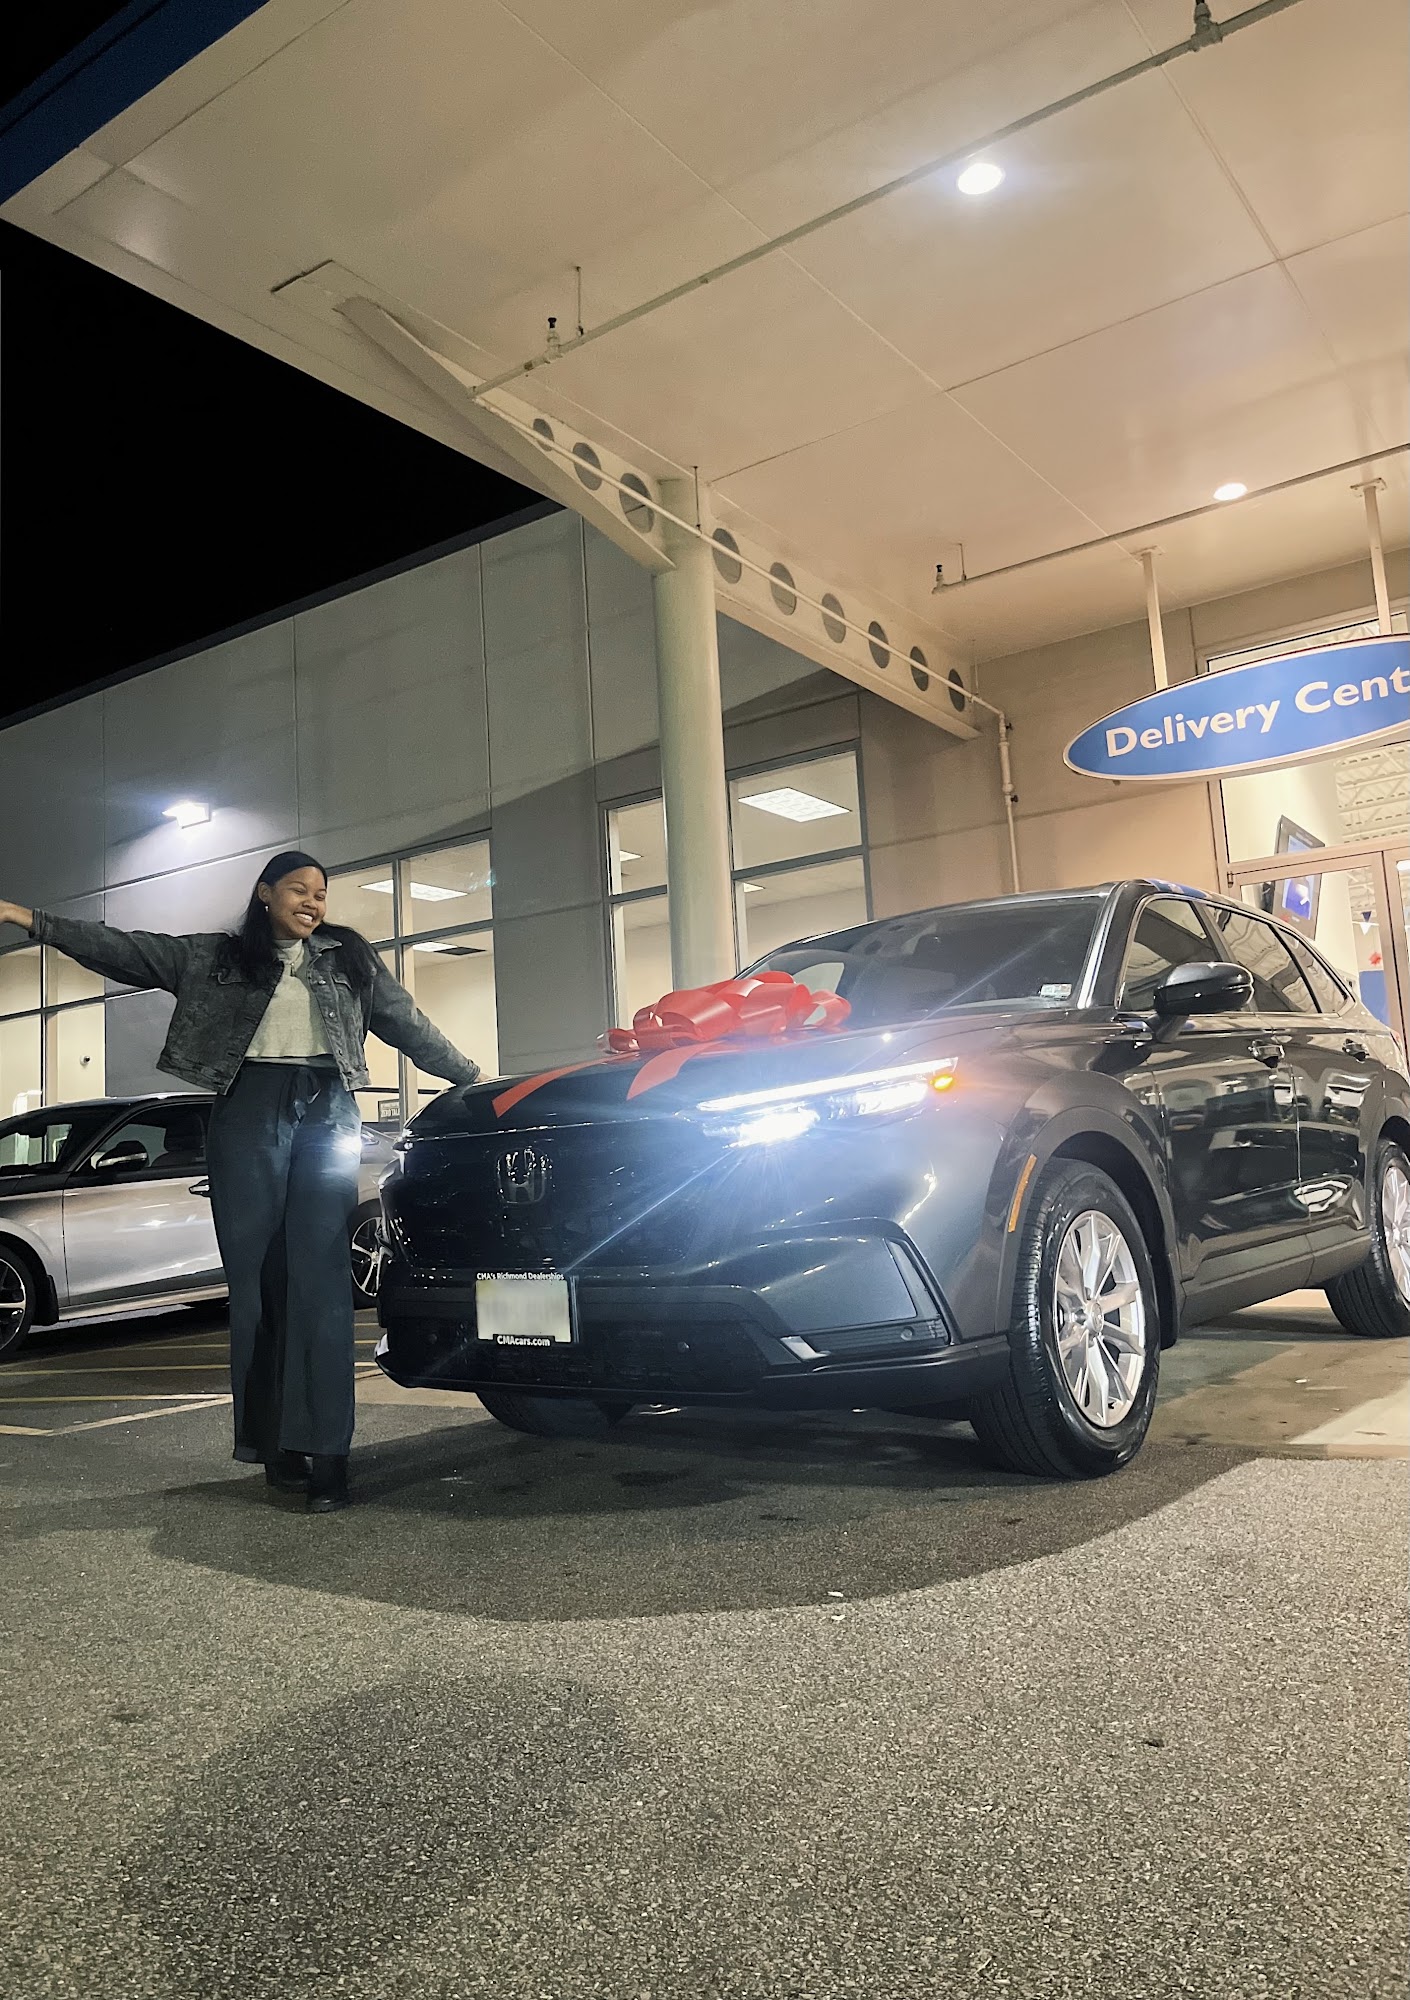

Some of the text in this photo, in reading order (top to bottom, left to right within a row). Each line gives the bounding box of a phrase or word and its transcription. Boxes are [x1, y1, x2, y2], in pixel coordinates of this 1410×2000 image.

[1105, 666, 1410, 758] Delivery Cent
[496, 1272, 527, 1280] Richmond
[528, 1272, 564, 1281] Dealerships
[496, 1335, 551, 1347] CMAcars.com
